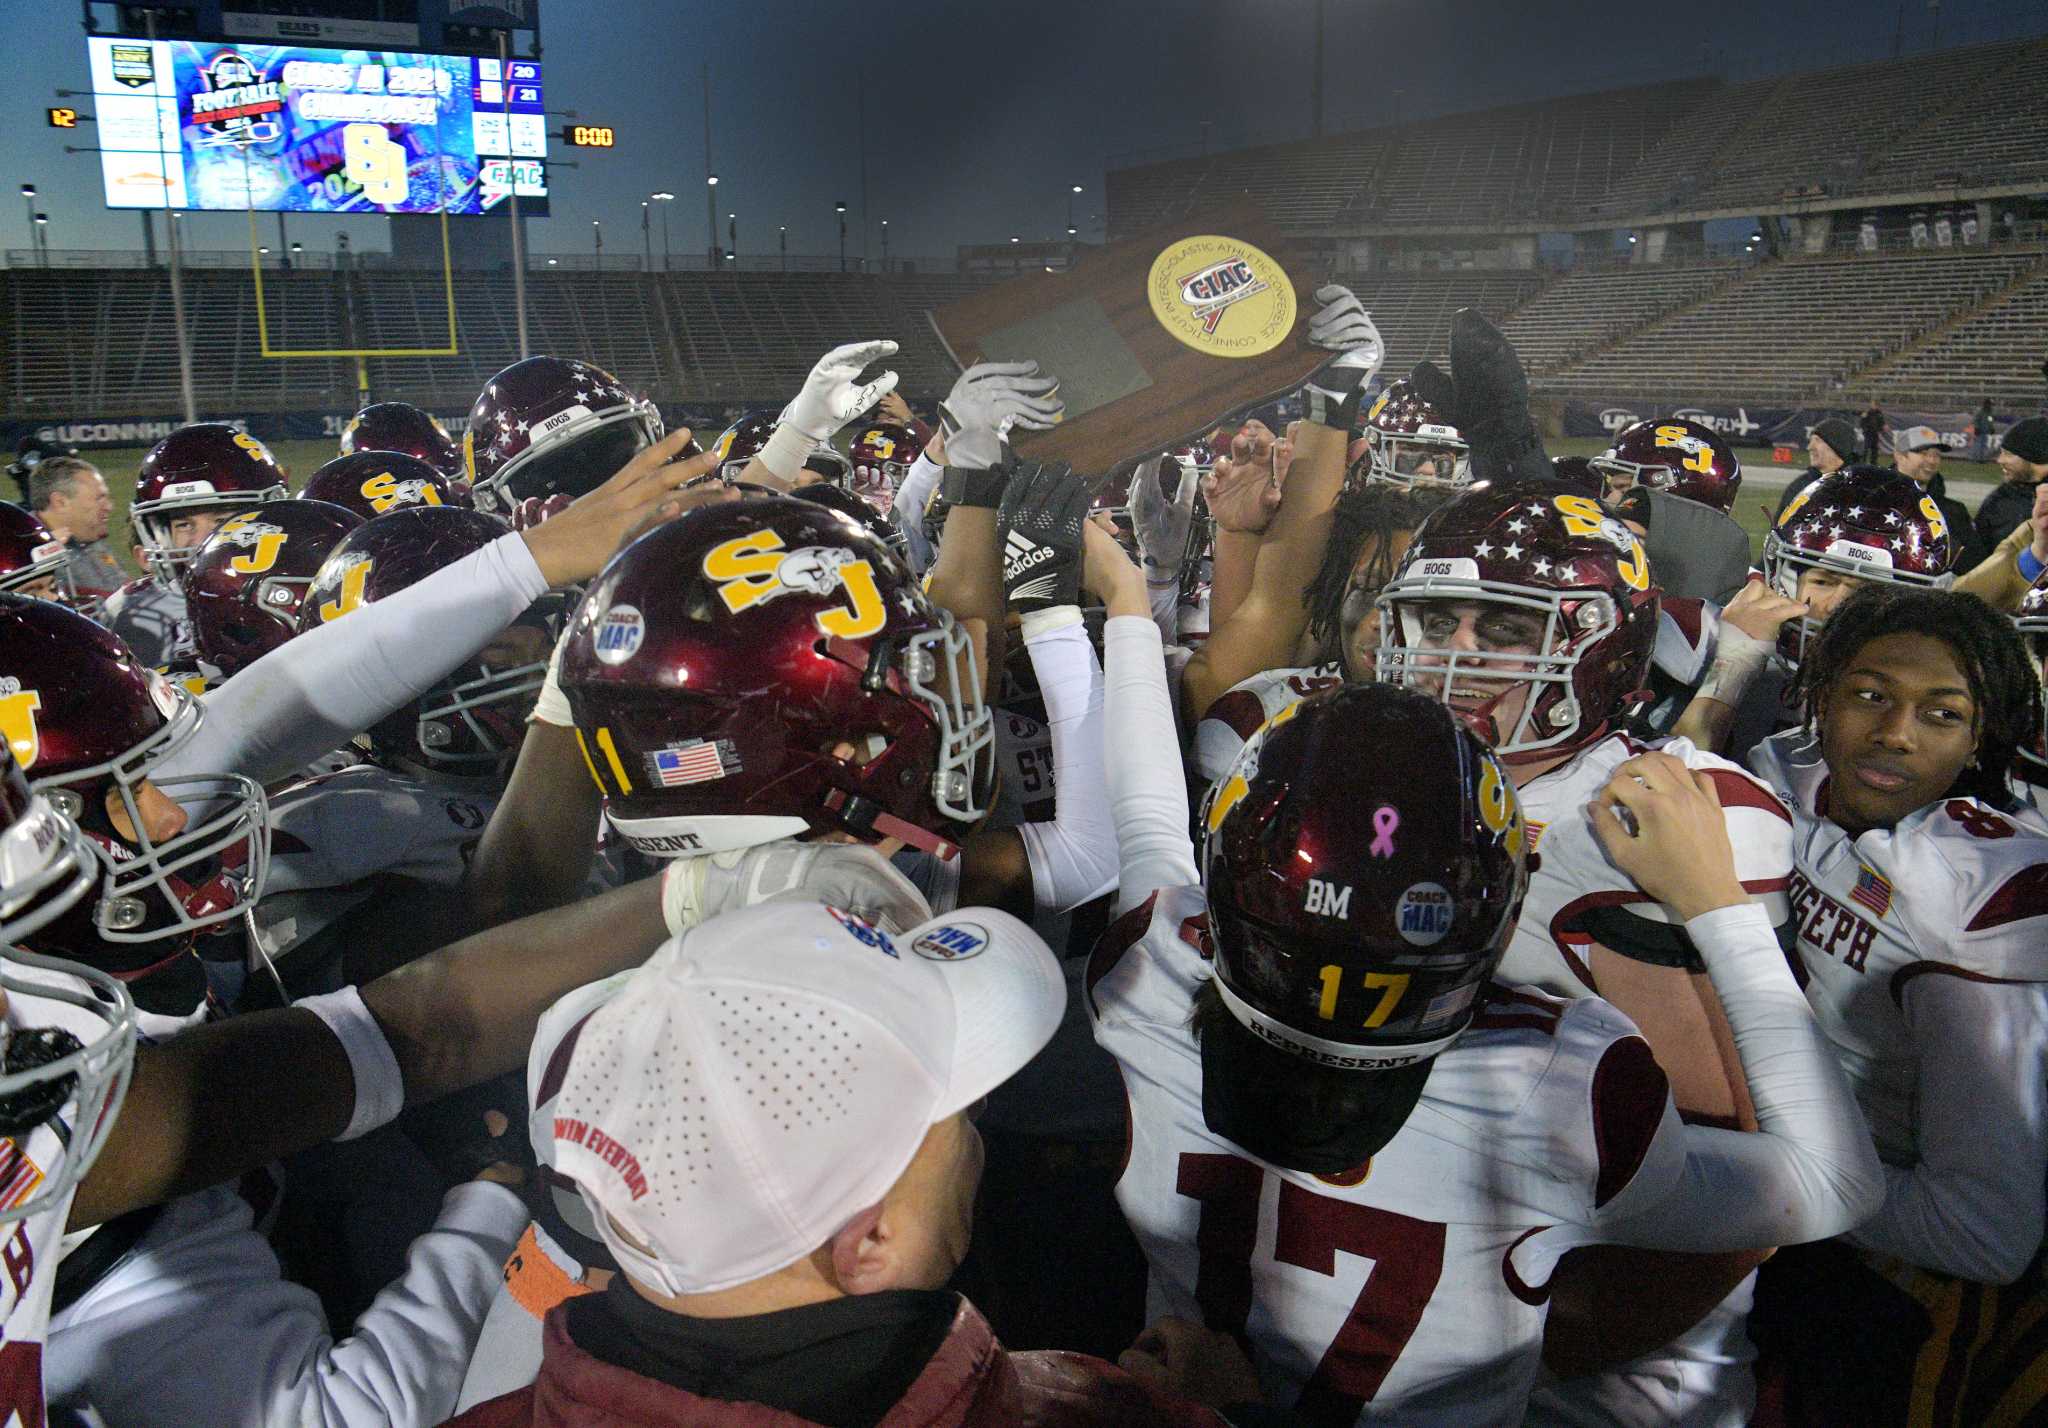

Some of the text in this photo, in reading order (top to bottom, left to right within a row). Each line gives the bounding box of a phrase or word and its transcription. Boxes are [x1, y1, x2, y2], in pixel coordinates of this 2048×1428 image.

[514, 65, 536, 79] 20
[519, 88, 537, 101] 21
[574, 126, 613, 147] 0:00
[491, 166, 540, 184] CIAC
[1217, 242, 1271, 274] ATHLETIC
[1189, 261, 1253, 300] CIAC
[544, 412, 571, 432] HOGS
[1004, 546, 1055, 582] adidas
[1848, 546, 1873, 561] HOGS
[1424, 562, 1451, 576] HOGS
[597, 625, 639, 652] MAC
[1304, 878, 1352, 921] BM
[1407, 891, 1449, 904] COACH
[1401, 903, 1450, 934] MAC
[1786, 868, 1878, 975] OSEPH
[926, 926, 984, 954] MAC
[1319, 965, 1410, 1029] 17
[1249, 1017, 1418, 1071] REPRESENT
[554, 1118, 649, 1201] WIN EVERYDAY
[1176, 1152, 1447, 1428] 17
